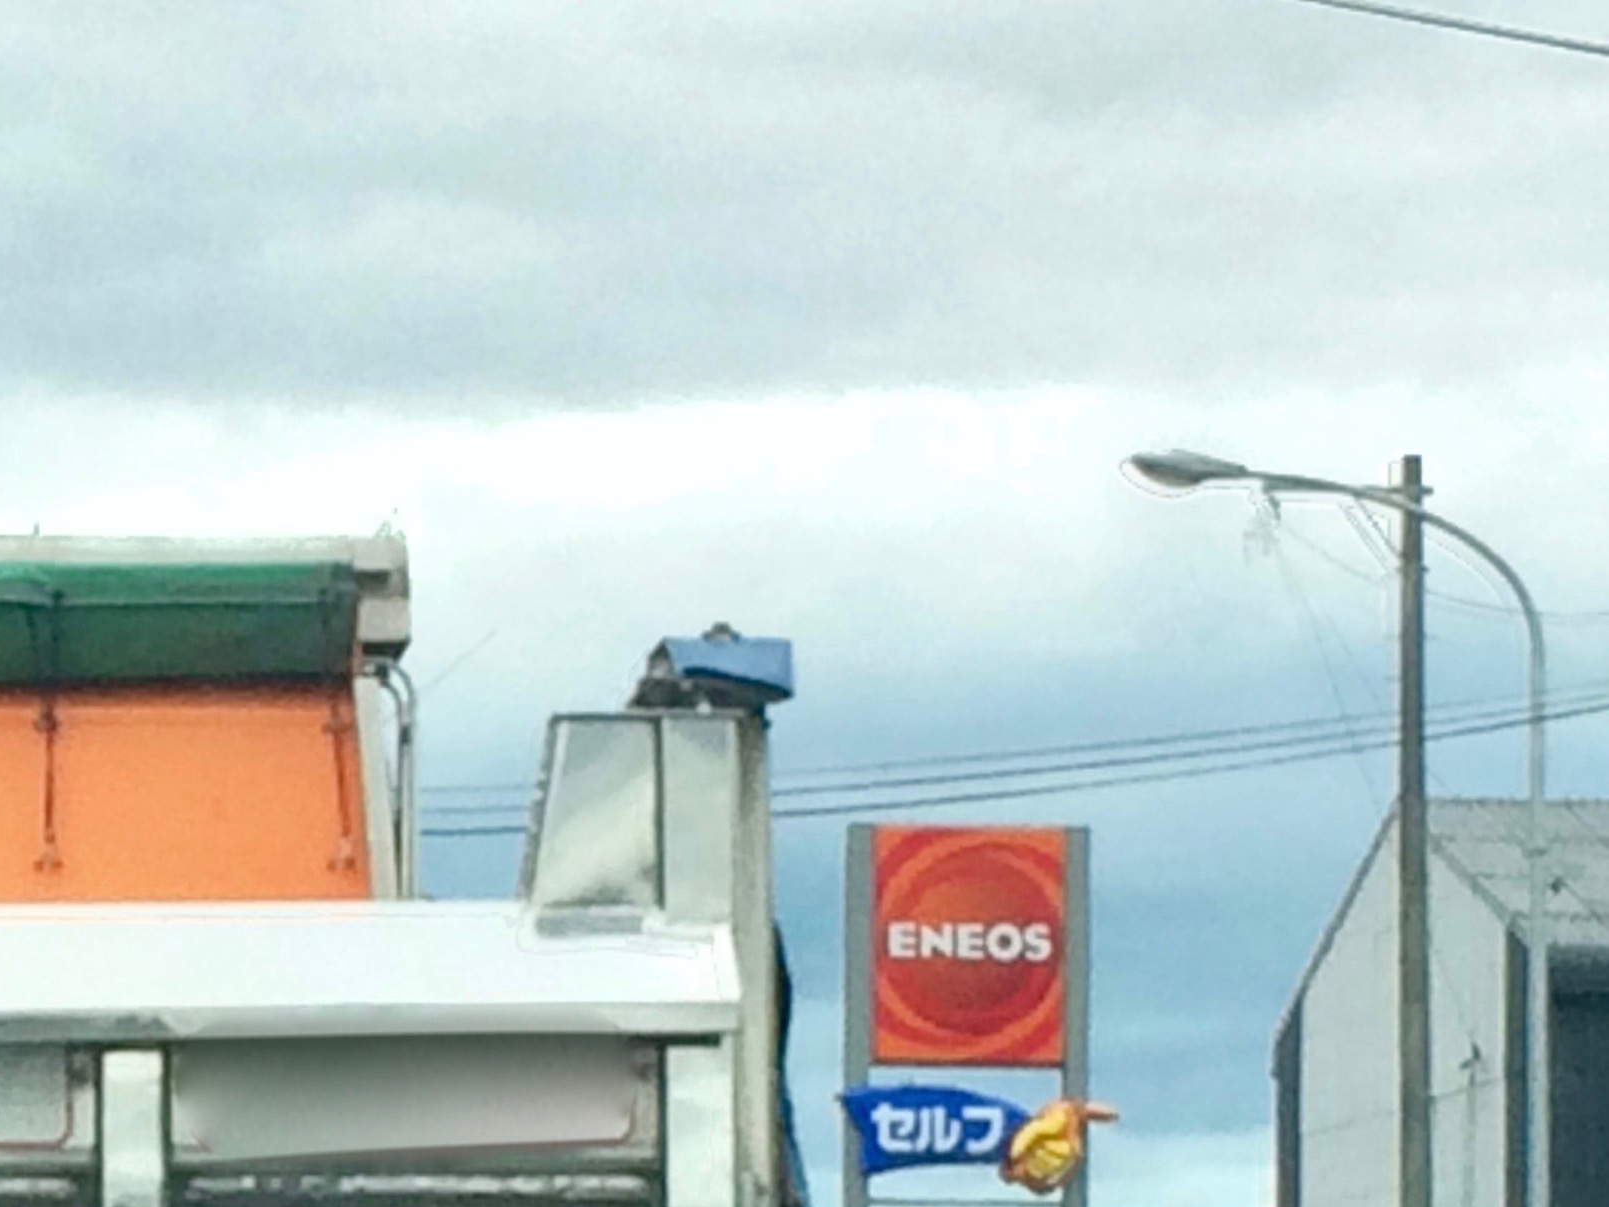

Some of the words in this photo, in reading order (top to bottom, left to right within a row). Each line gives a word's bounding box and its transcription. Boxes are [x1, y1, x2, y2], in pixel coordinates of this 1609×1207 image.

[888, 921, 1052, 962] ENEOS
[871, 1105, 1004, 1154] セルフ
